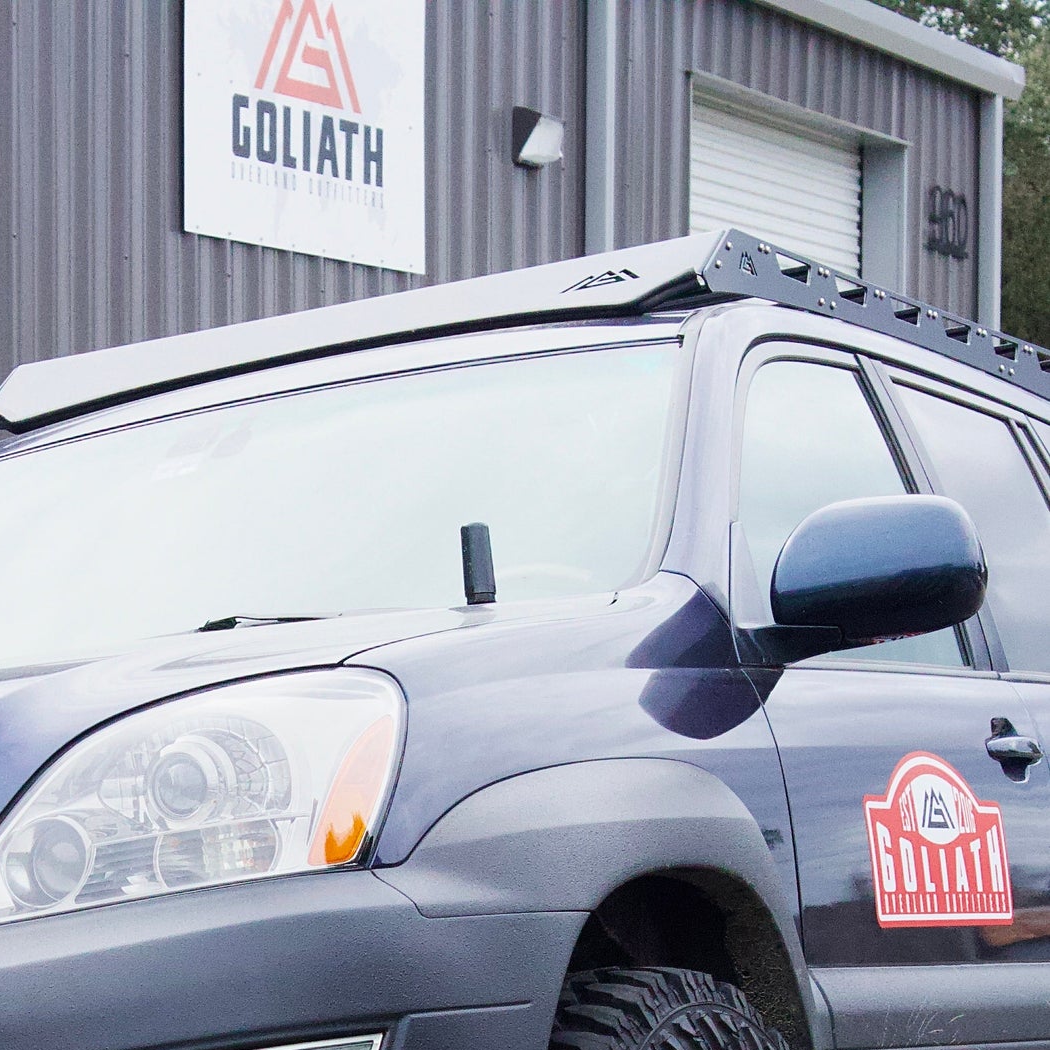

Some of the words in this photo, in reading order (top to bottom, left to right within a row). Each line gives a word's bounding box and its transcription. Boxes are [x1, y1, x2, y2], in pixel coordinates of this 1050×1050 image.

[230, 161, 297, 192] OVERLAND
[232, 93, 384, 188] GOLIATH
[876, 821, 1005, 893] GOLIATH
